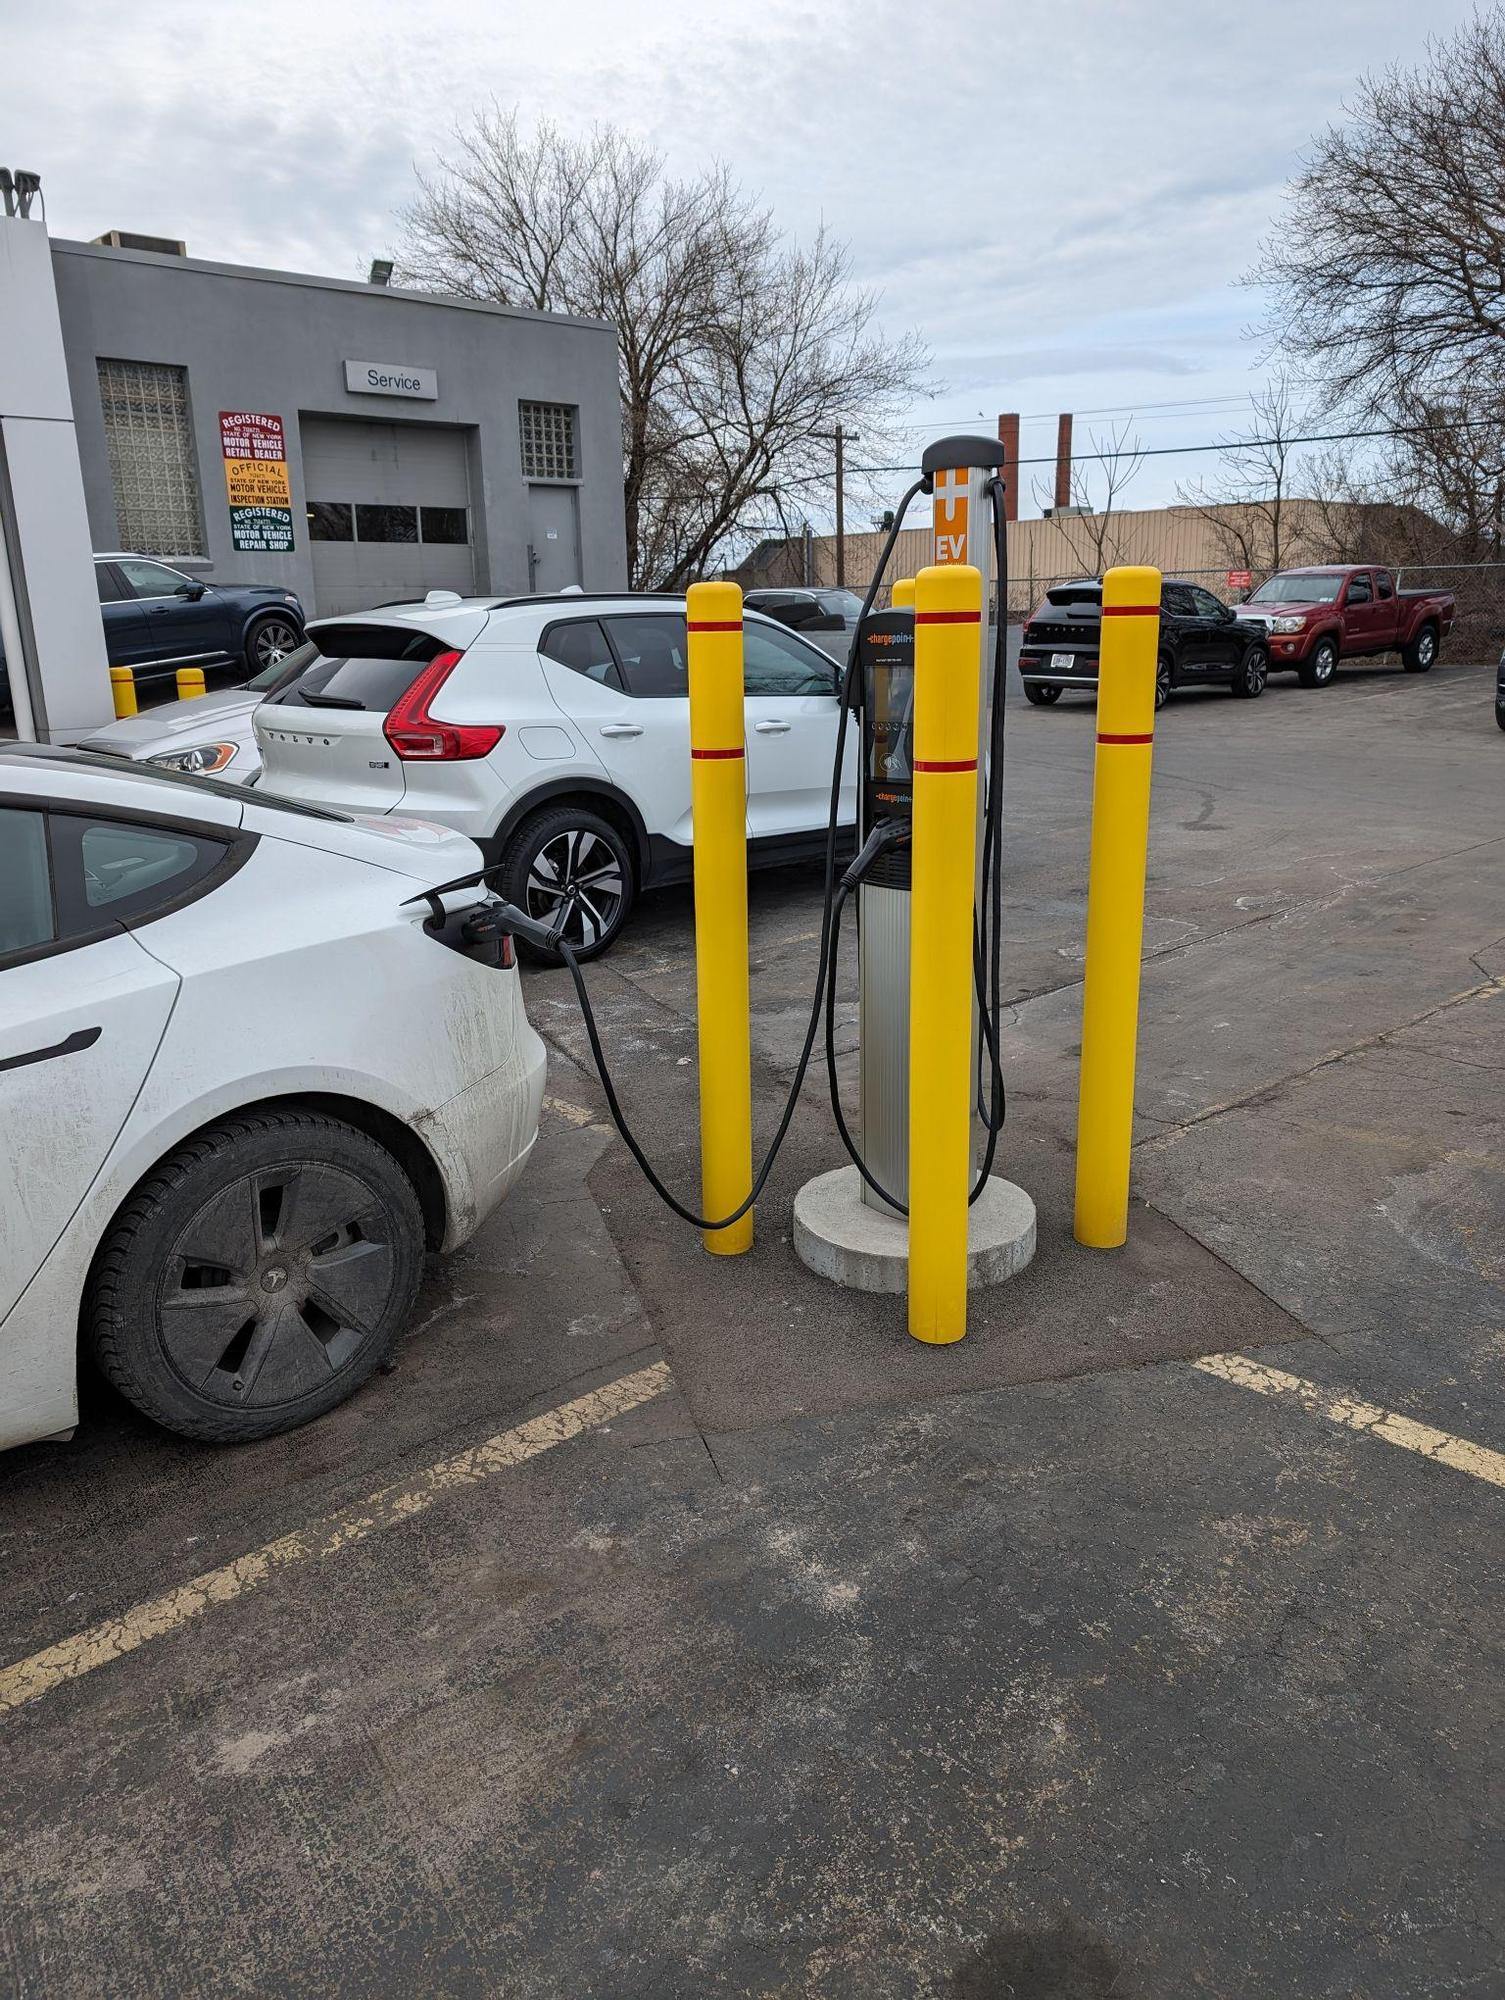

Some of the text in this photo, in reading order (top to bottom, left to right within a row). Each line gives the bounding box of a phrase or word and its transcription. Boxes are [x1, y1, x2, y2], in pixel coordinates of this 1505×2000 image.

[368, 369, 420, 391] Service
[222, 414, 280, 432] REGISTERED
[223, 437, 283, 450] MOTOR VEHICLE
[225, 447, 283, 460] RETAIL DEALER
[231, 462, 283, 478] OFFICIAL
[230, 484, 287, 494] MOTOR VEHICLE
[230, 495, 289, 505] INSPECTION STATION
[233, 507, 290, 523] REGISTERED
[233, 530, 293, 540] MOTOR VEHICLE
[240, 540, 289, 550] REPAIR SHOP
[936, 534, 966, 561] EV
[269, 732, 330, 745] VOLVO
